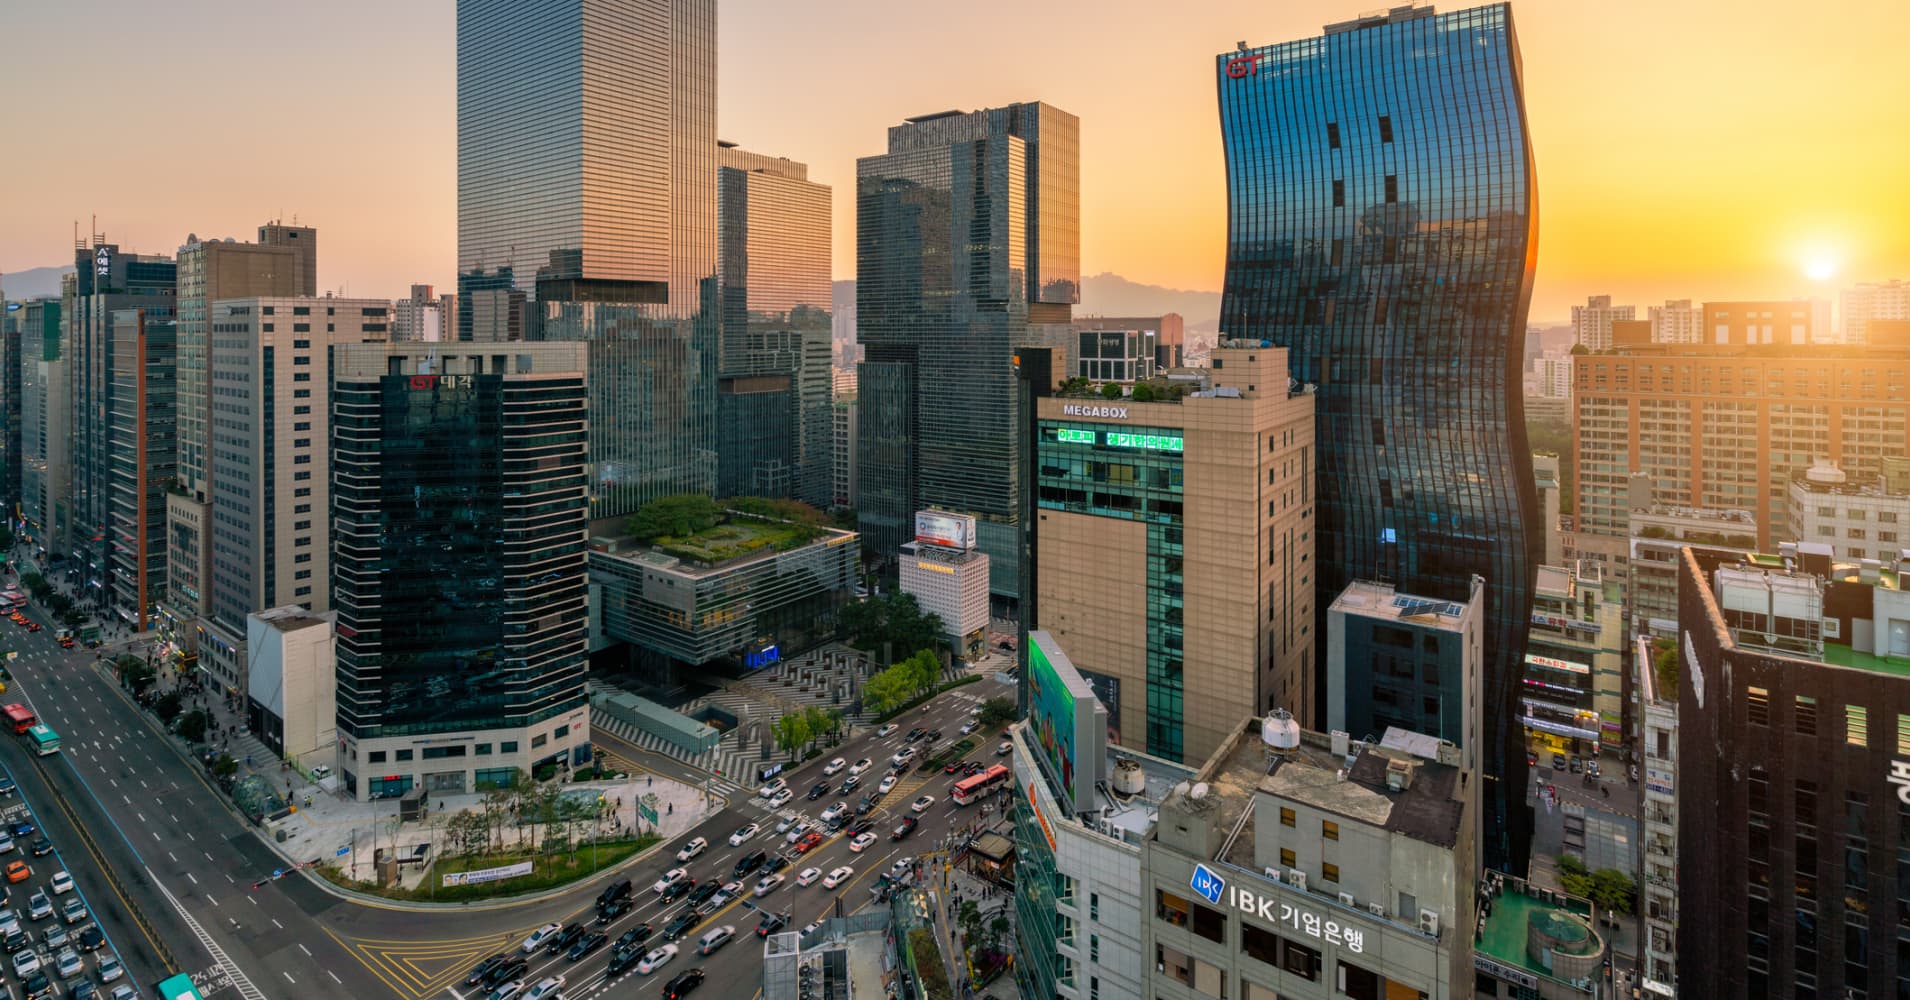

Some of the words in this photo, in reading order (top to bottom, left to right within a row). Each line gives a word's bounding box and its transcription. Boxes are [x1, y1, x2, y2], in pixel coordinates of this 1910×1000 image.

[1226, 54, 1265, 78] GT
[1063, 405, 1128, 419] MEGABOX
[1230, 885, 1275, 922] IBK
[1280, 903, 1363, 953] 기업은행
